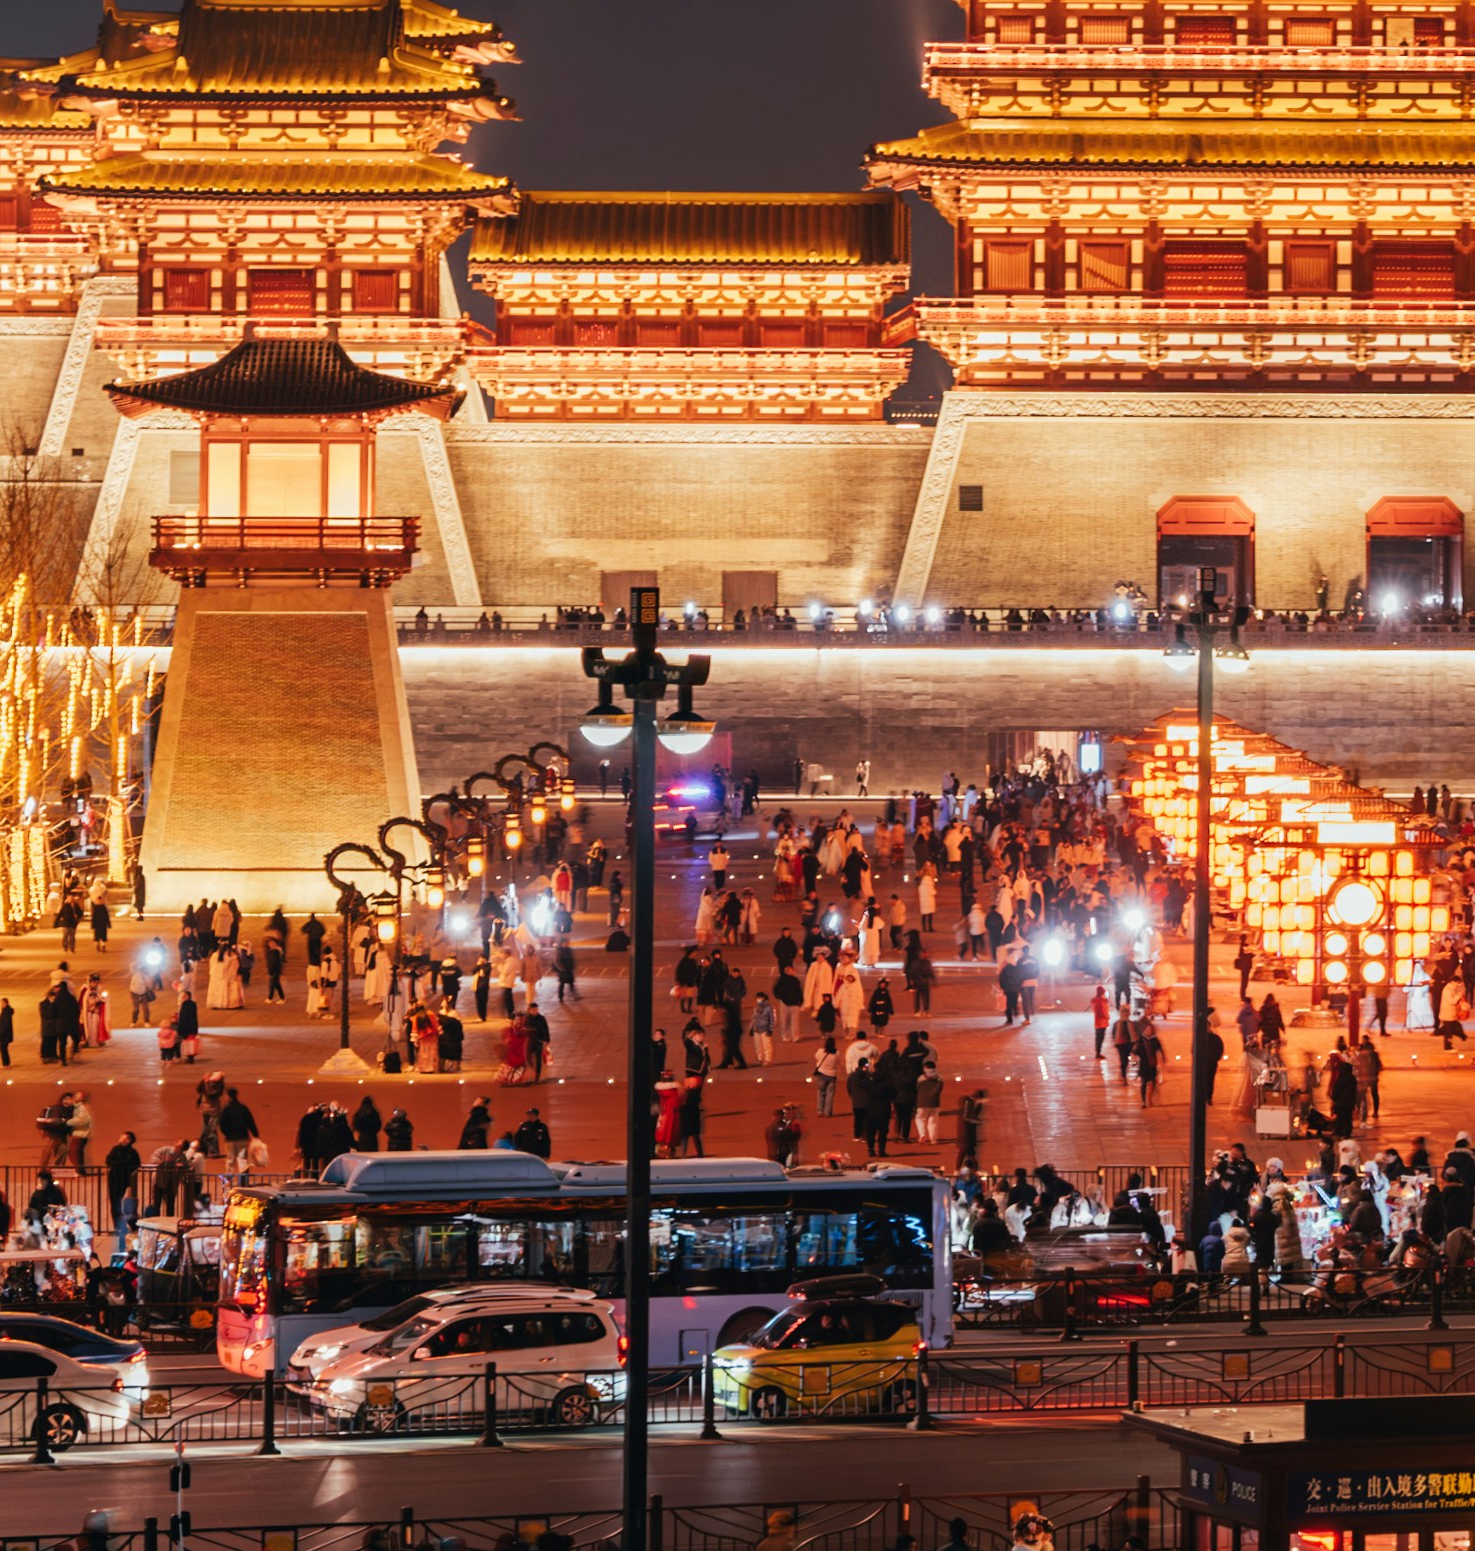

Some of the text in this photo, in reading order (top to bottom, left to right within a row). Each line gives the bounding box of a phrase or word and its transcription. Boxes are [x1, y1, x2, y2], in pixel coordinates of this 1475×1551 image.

[1231, 1481, 1256, 1503] POLICE
[1305, 1503, 1328, 1514] Joint
[1330, 1502, 1357, 1513] Police
[1357, 1501, 1390, 1512] Service
[1391, 1499, 1424, 1511] Station
[1424, 1498, 1438, 1509] for
